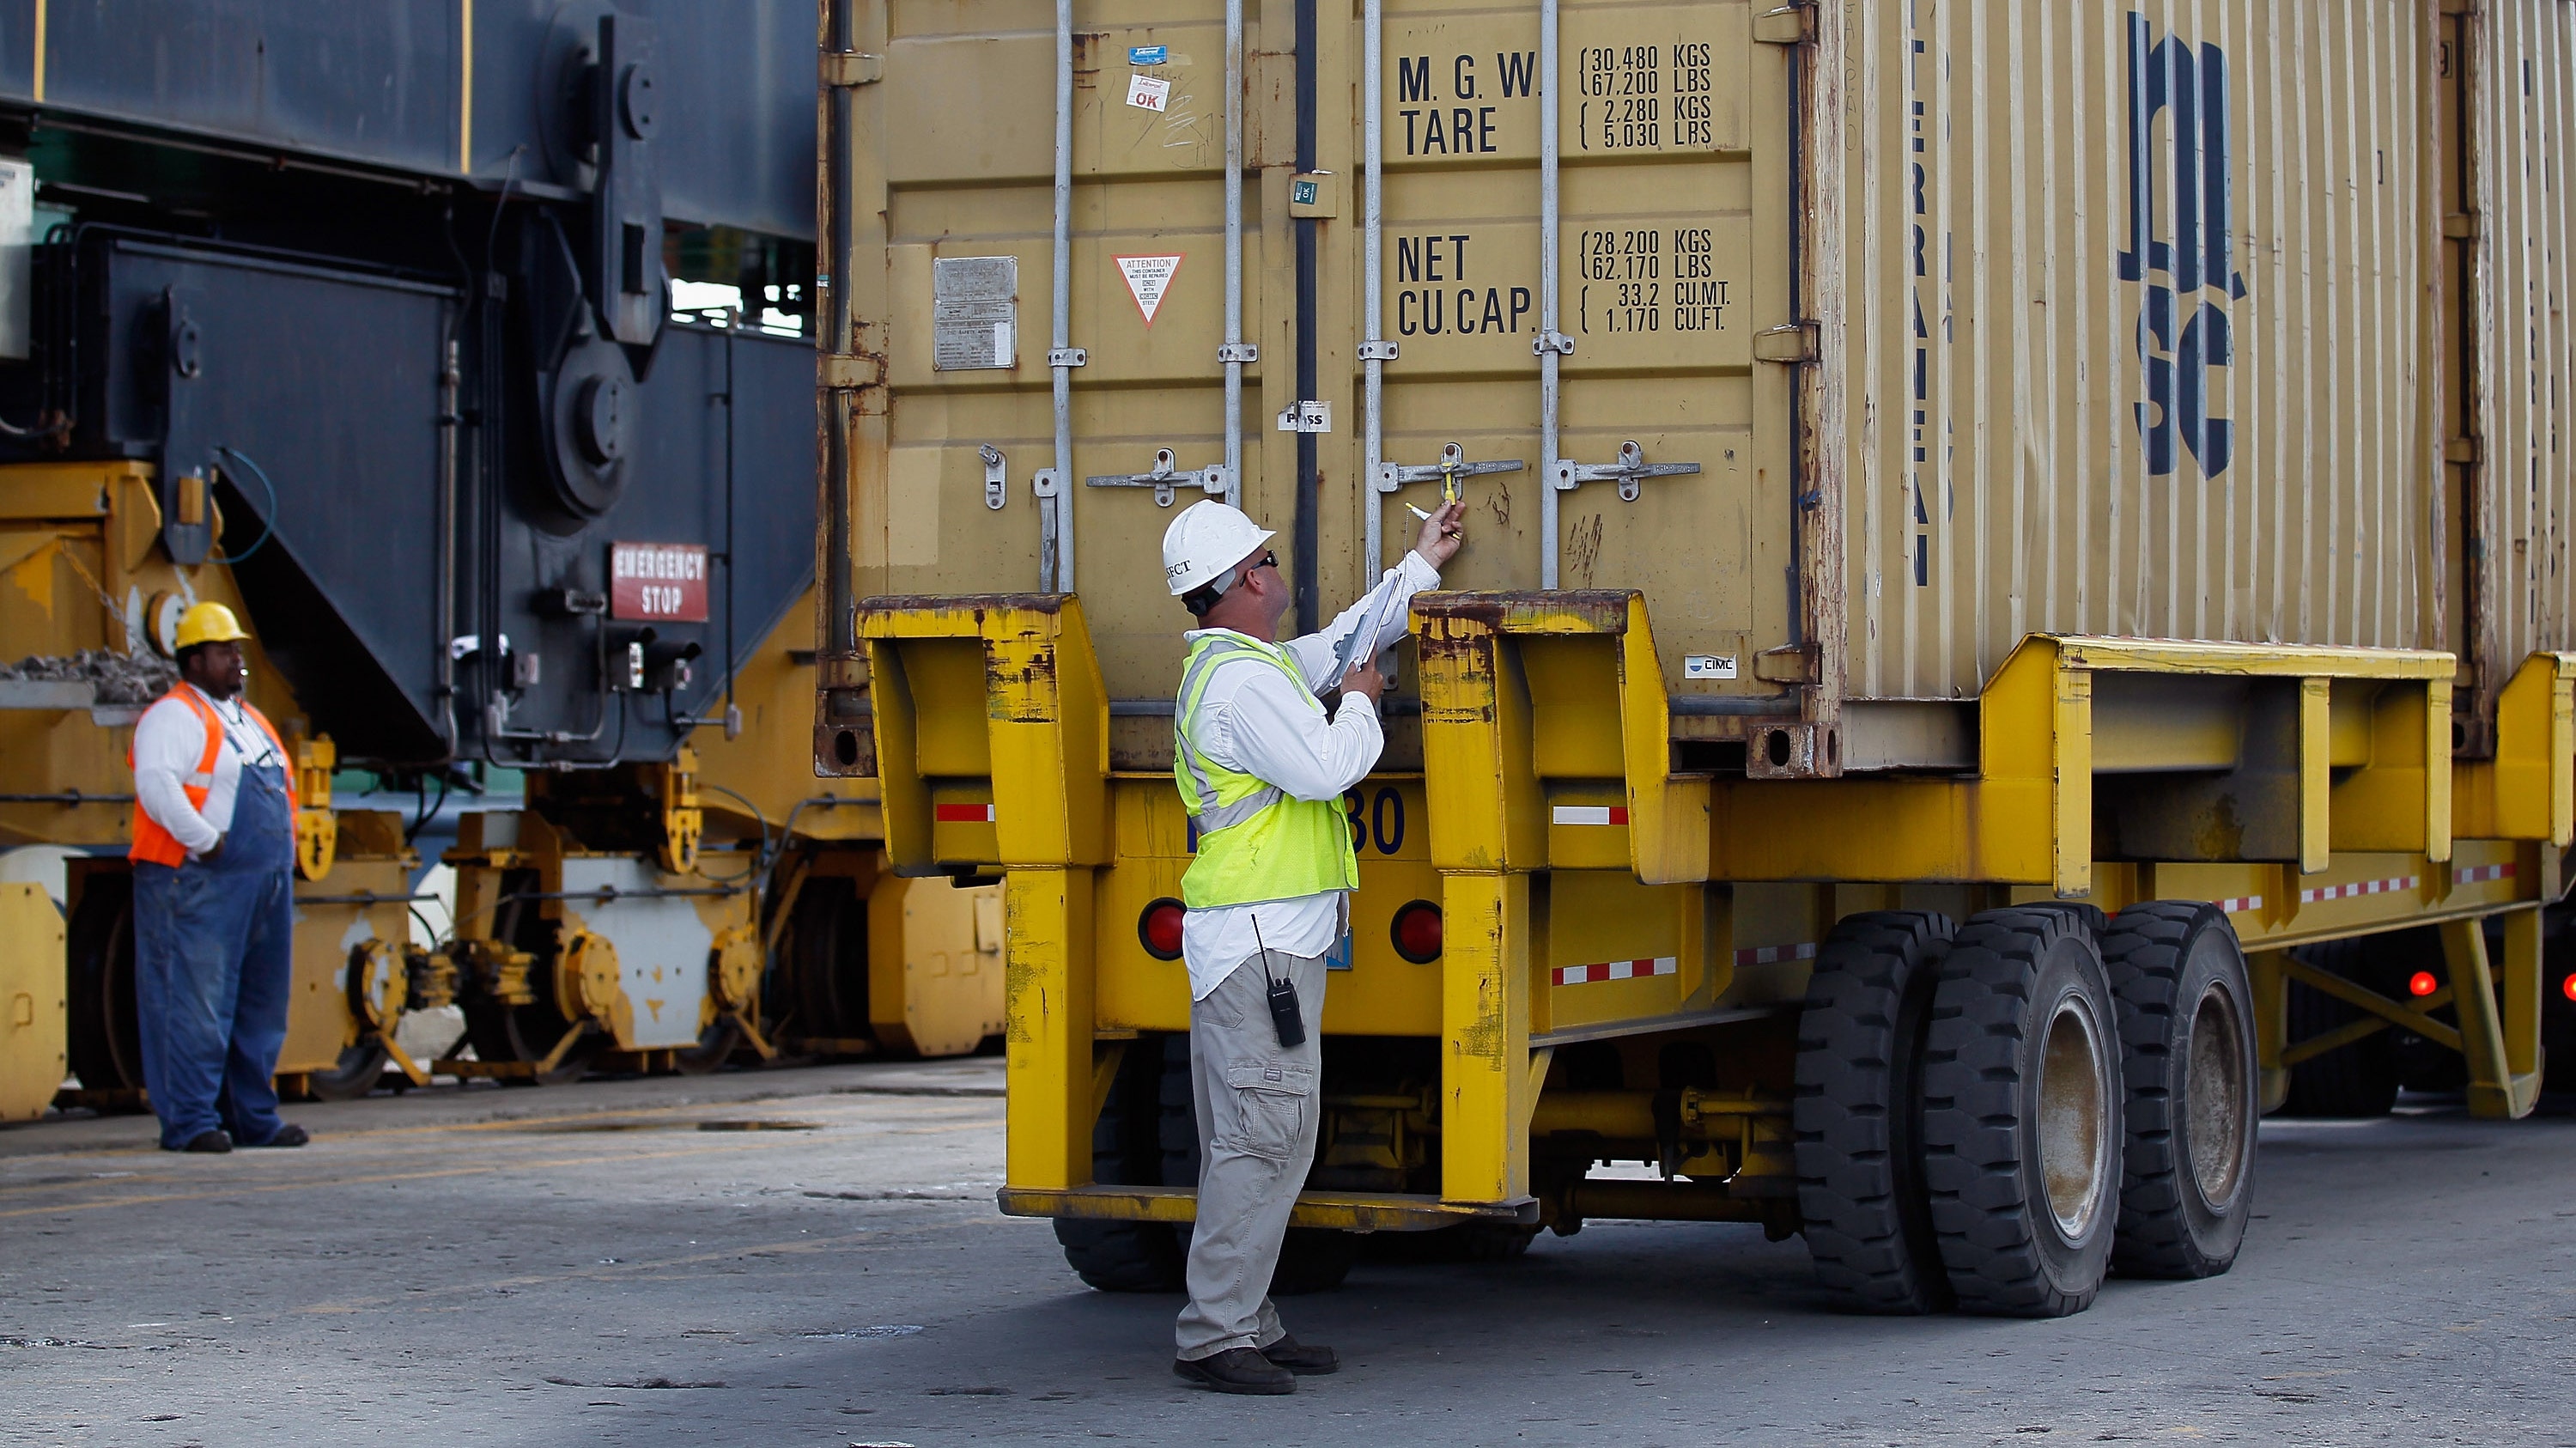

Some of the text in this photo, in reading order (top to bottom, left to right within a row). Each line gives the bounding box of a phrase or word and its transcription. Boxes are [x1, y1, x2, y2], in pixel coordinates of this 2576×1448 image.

[1591, 44, 1710, 72] 30,480 KGS
[1591, 69, 1710, 96] 67,200 LBS
[1136, 92, 1158, 109] OK
[1604, 95, 1711, 124] 2,280 KGS
[1400, 106, 1497, 155] TARE
[1604, 120, 1711, 148] 5,030 LBS
[1303, 187, 1309, 198] OK
[1592, 228, 1711, 255] 28,200 KGS
[1127, 259, 1171, 269] ATTENTION
[1398, 234, 1470, 283] NET
[1593, 254, 1711, 280] 62,170 LBS
[1619, 281, 1730, 307] 33.2 CU.MT.
[1399, 287, 1536, 336] CU.CAP.
[1606, 307, 1725, 332] 1,170 CU.FT.
[616, 550, 706, 580] EMERGENCY
[641, 585, 683, 614] STOP
[1704, 660, 1733, 670] CIMC
